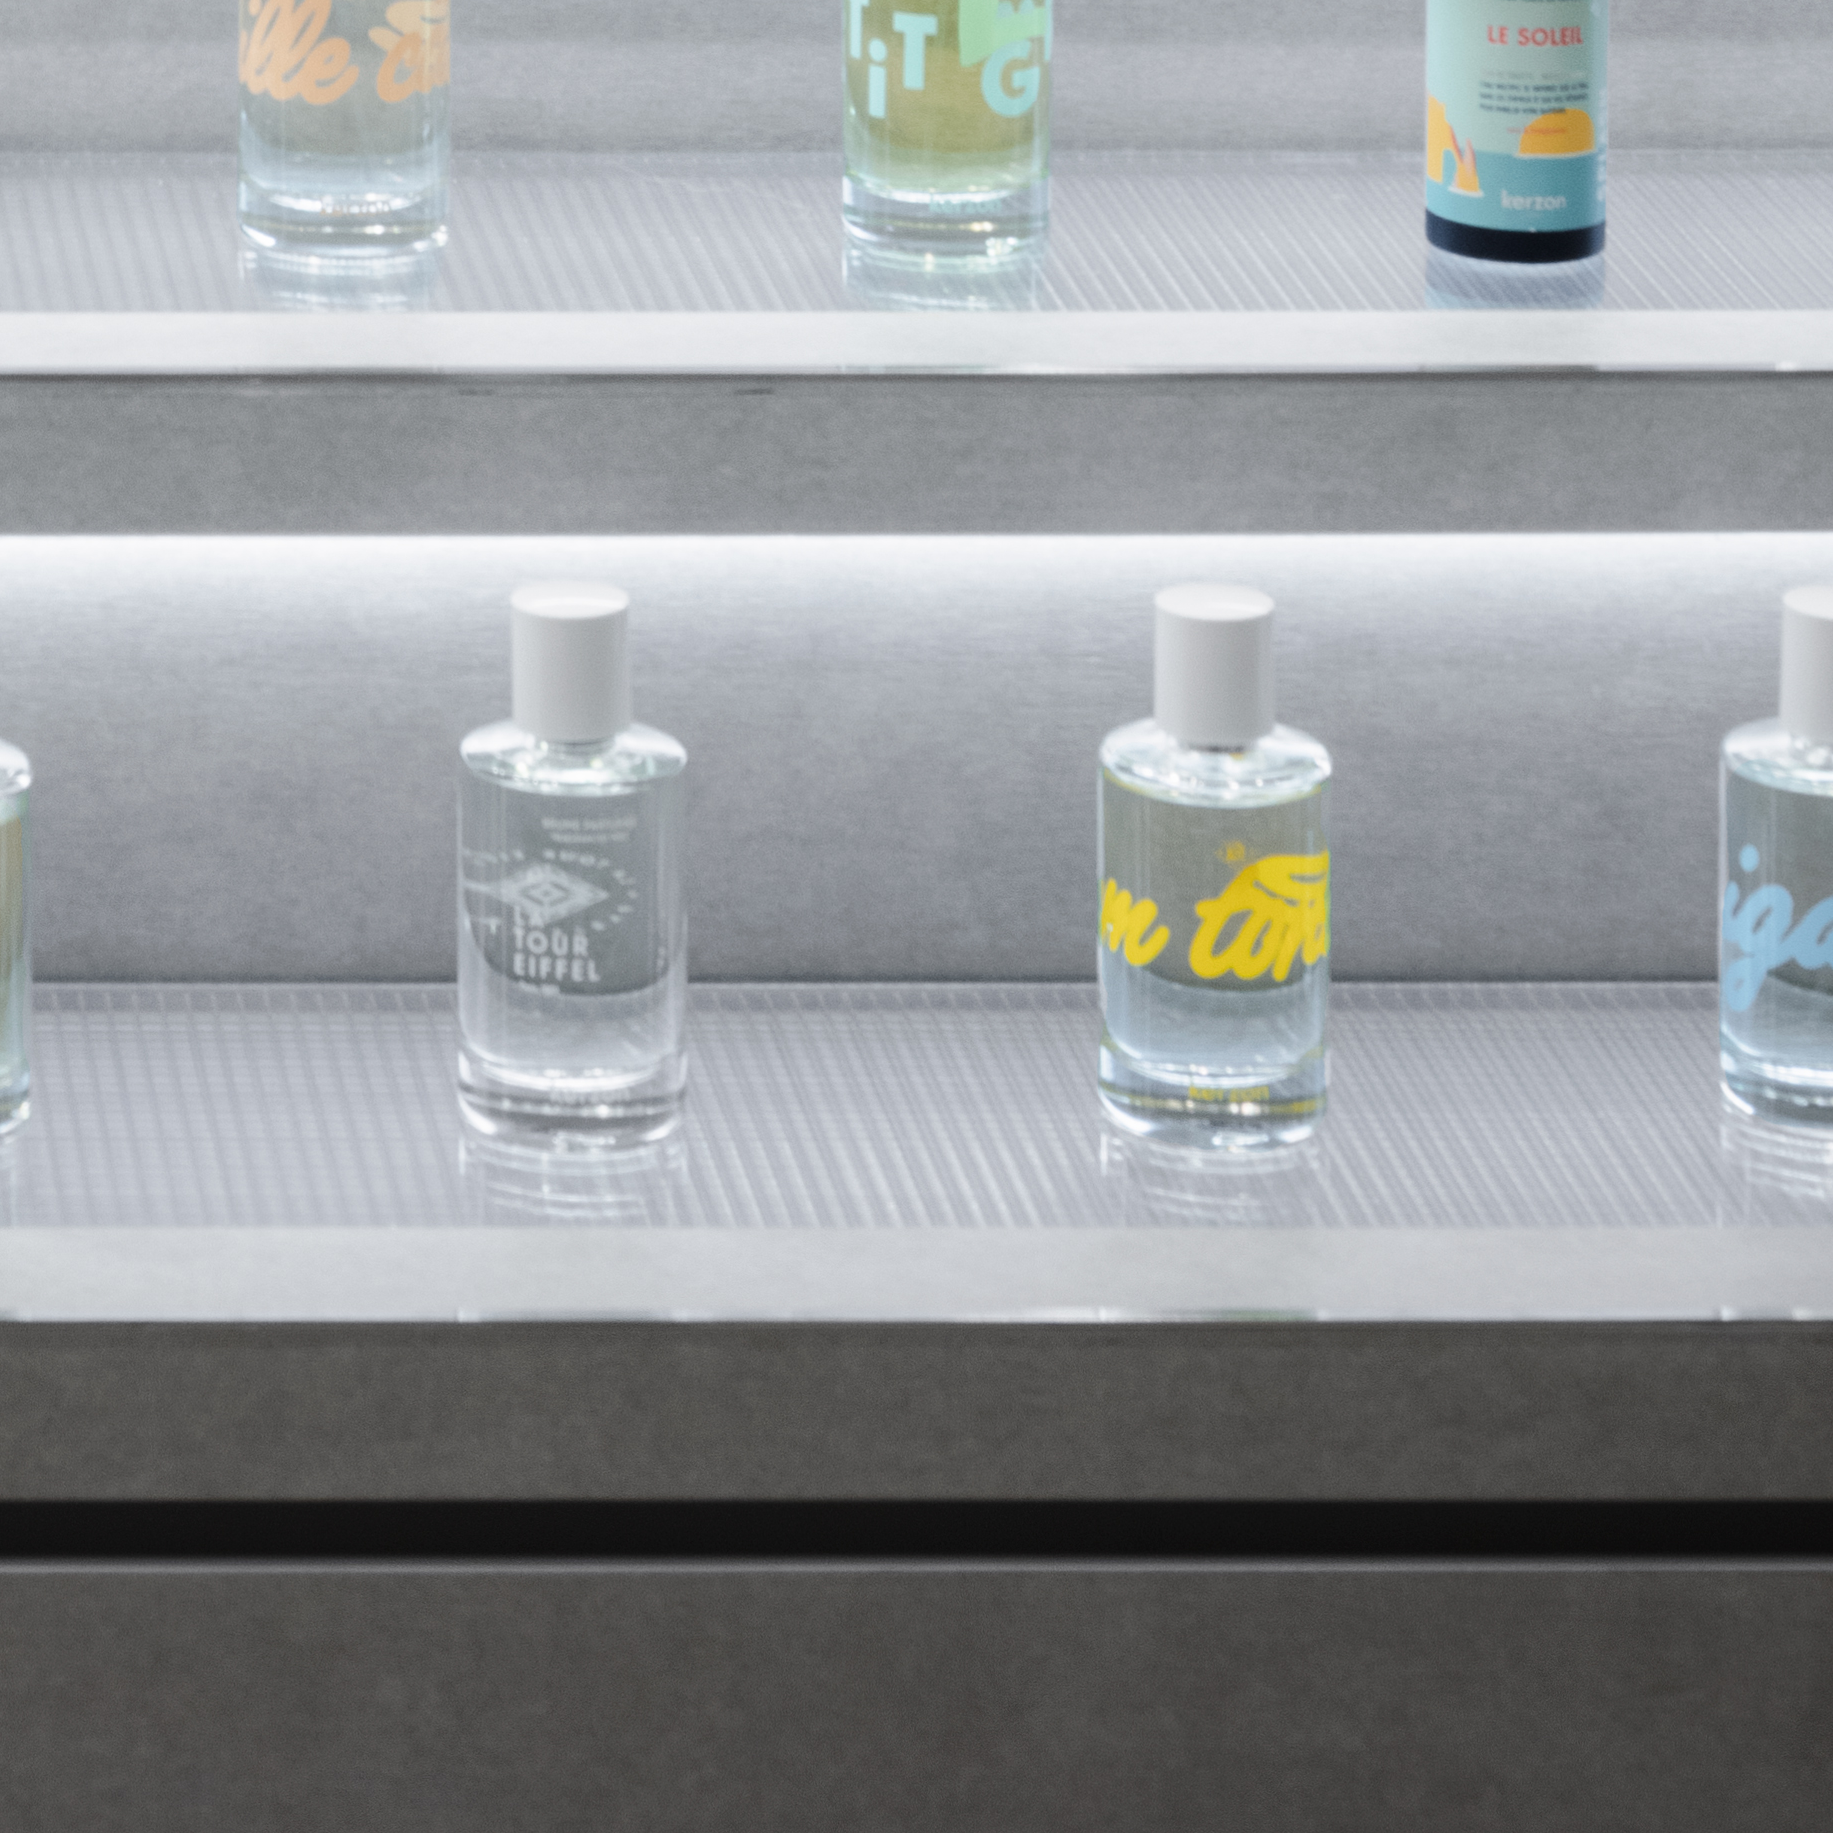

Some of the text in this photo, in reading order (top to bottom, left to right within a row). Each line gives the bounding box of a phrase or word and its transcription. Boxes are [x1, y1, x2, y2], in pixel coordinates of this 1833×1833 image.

[1487, 25, 1584, 47] LE SOLEIL
[1500, 188, 1566, 211] kerzon
[513, 925, 589, 957] TOUR
[513, 952, 601, 982] EIFFEL
